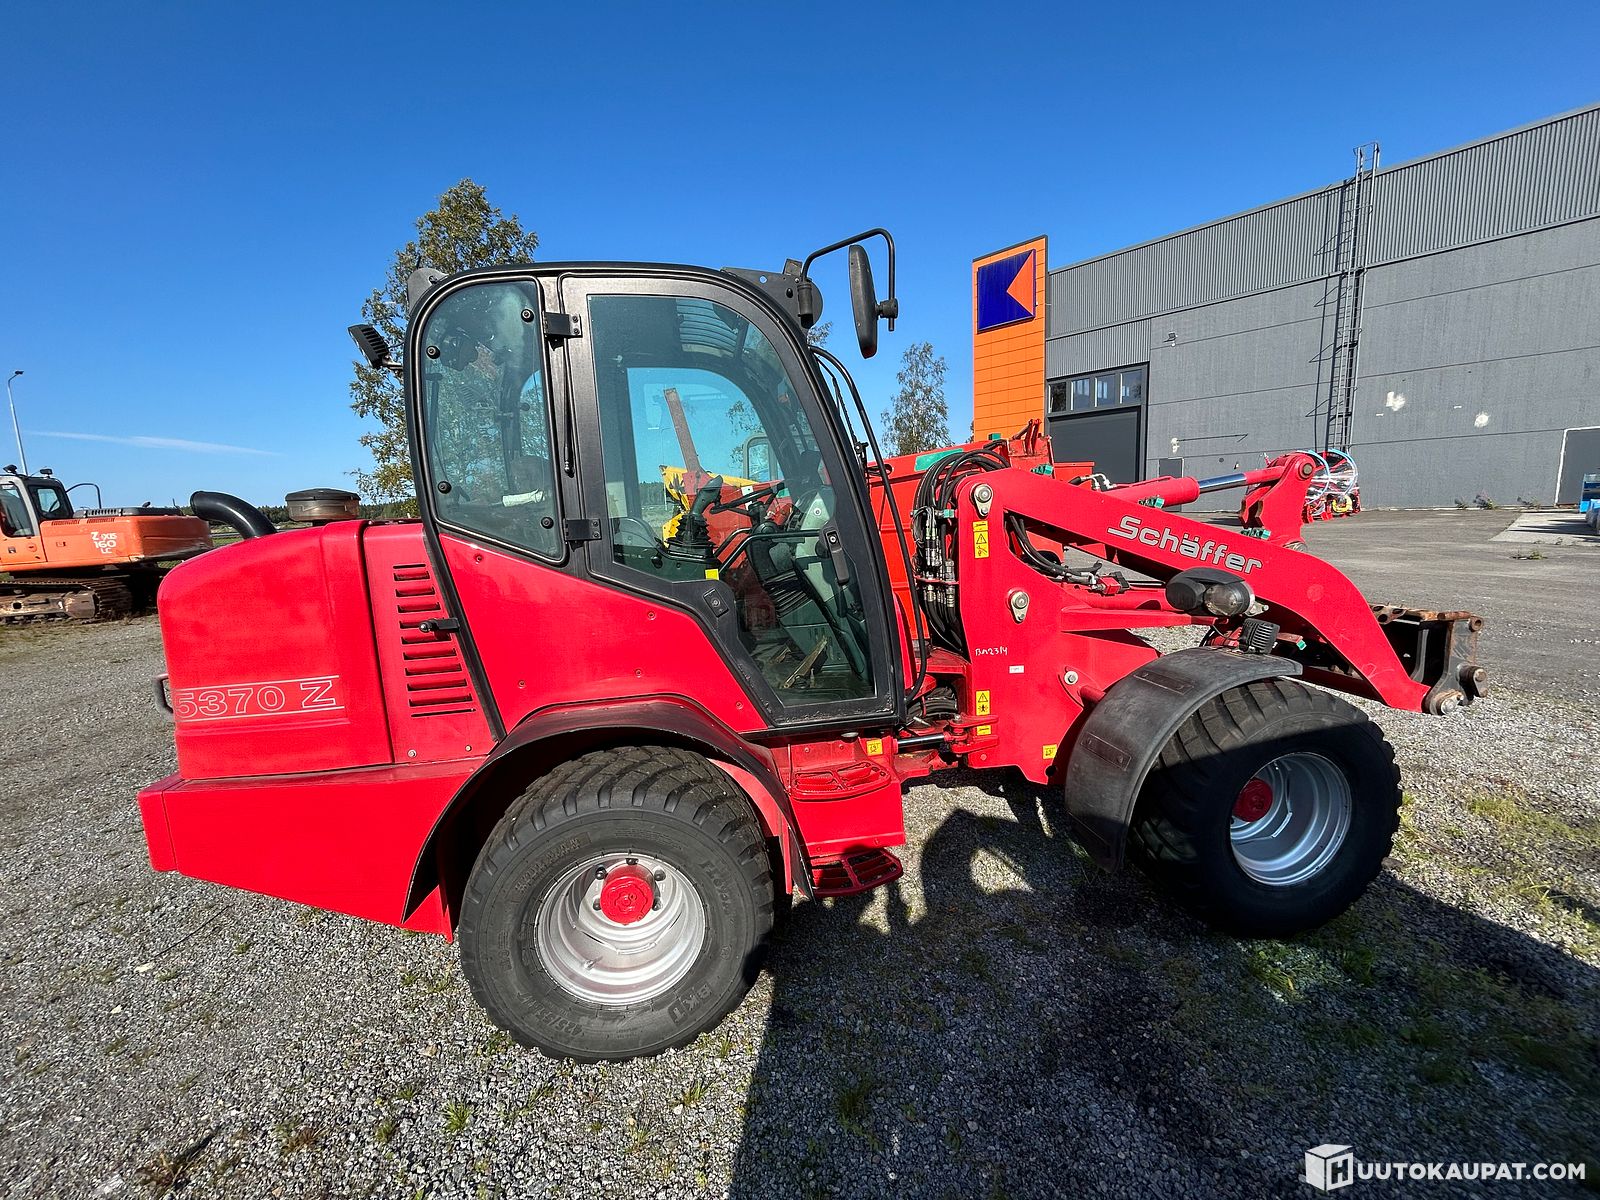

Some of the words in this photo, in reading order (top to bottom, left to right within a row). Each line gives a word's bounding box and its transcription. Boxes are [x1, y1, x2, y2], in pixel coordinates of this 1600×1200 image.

[94, 540, 117, 548] 160
[1107, 515, 1262, 574] Schäffer
[176, 686, 286, 718] 5370
[300, 680, 337, 708] Z
